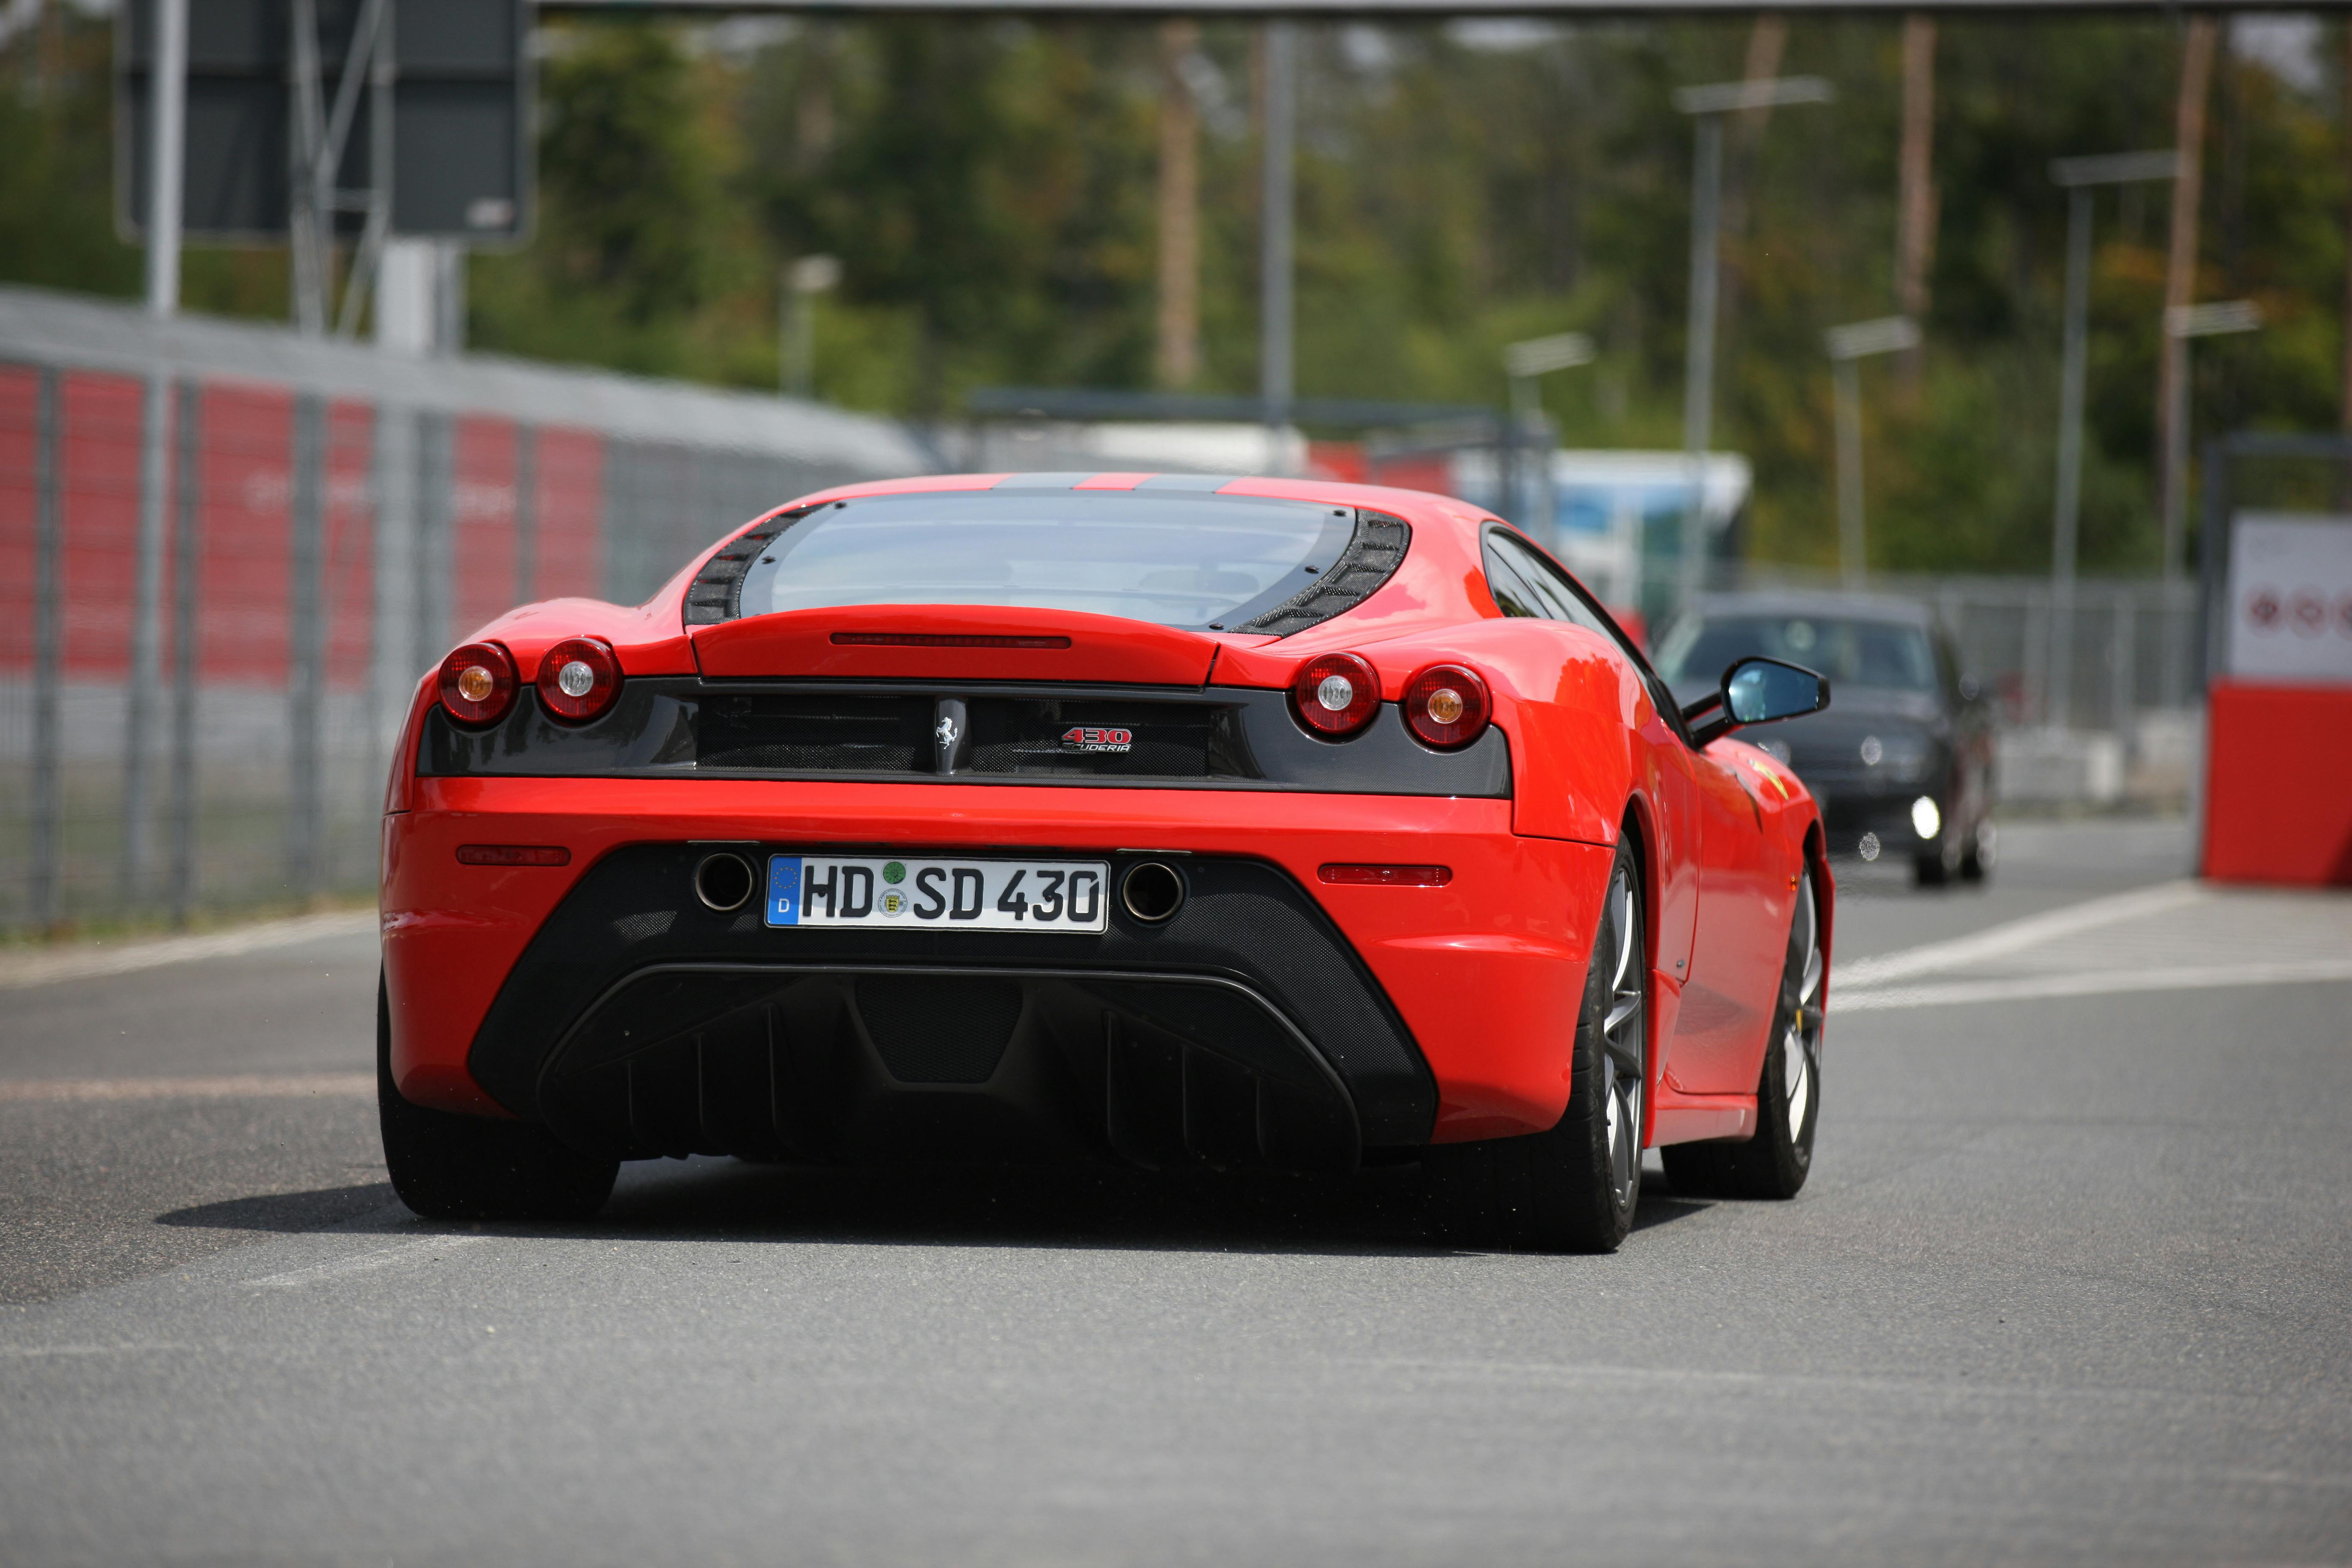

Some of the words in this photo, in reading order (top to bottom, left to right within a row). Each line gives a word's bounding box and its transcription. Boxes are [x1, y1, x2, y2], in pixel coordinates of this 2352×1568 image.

[1062, 727, 1132, 744] 430
[1062, 743, 1131, 752] SCUDERIA
[802, 866, 874, 918] HD
[914, 867, 984, 920] SD
[998, 870, 1099, 922] 430
[779, 898, 789, 913] D
